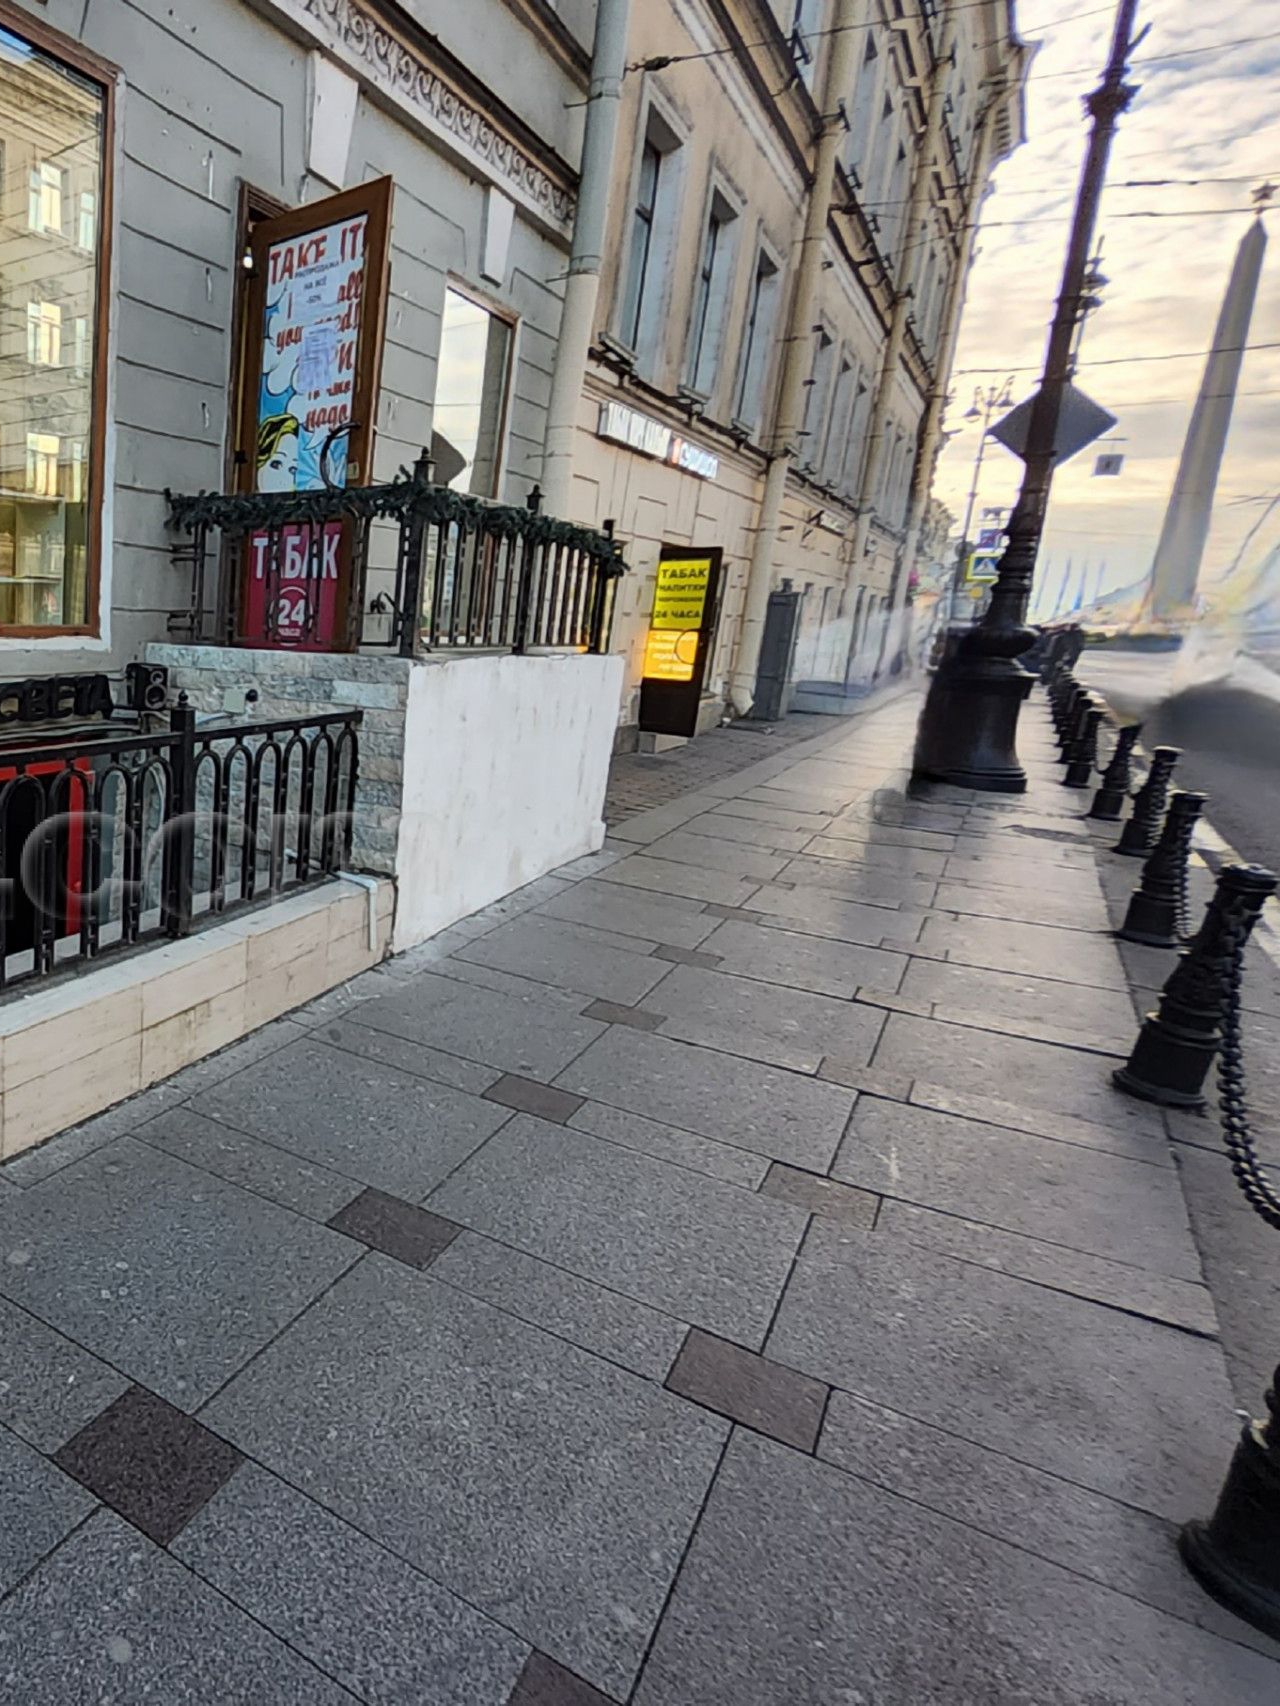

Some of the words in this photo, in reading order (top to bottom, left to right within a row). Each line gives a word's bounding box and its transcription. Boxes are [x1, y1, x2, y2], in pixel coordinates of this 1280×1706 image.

[270, 235, 328, 286] TAKE
[662, 568, 707, 578] ТАБАК
[277, 599, 305, 626] 24
